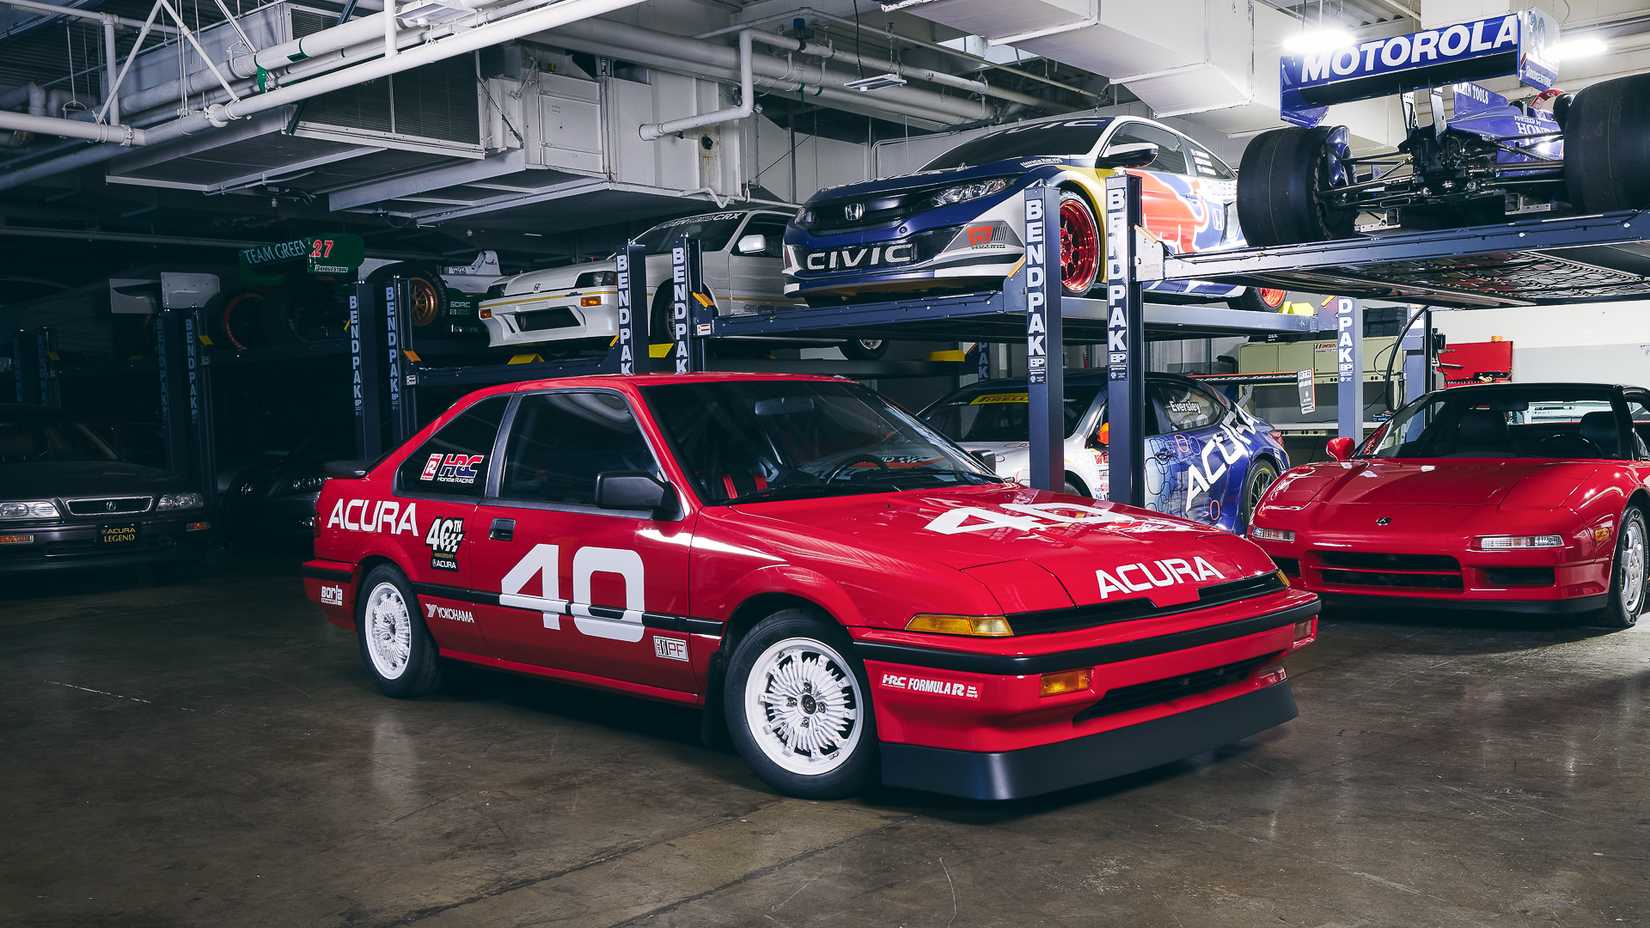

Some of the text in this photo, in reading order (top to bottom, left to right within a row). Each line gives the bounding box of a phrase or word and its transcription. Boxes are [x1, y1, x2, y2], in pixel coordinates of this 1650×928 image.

[1302, 15, 1518, 82] MOTOROLA
[1472, 84, 1489, 105] TOOLS
[713, 212, 742, 221] CRX
[243, 246, 276, 264] TEAM
[310, 239, 333, 258] 27
[807, 244, 913, 270] CIVIC
[1026, 200, 1045, 355] BENDPAK
[1107, 188, 1127, 351] BEDPAK
[617, 255, 632, 375] BENDPAK
[672, 248, 688, 374] BENDPAK
[349, 296, 361, 399] BENDPAK
[385, 287, 399, 394] BENDPAK
[1030, 358, 1045, 367] BP
[1110, 353, 1126, 363] BP
[1169, 401, 1200, 414] Eversley
[439, 454, 484, 477] HRC
[1186, 402, 1259, 512] ACURA
[327, 498, 419, 536] ACURA
[925, 502, 1135, 535] 40
[104, 534, 135, 543] LEGEND
[437, 560, 457, 569] ACURA
[1096, 556, 1227, 599] ACURA
[500, 543, 645, 643] 40
[436, 606, 475, 623] YOKOHAMA
[882, 674, 907, 686] HRC
[908, 678, 951, 695] FORMULA
